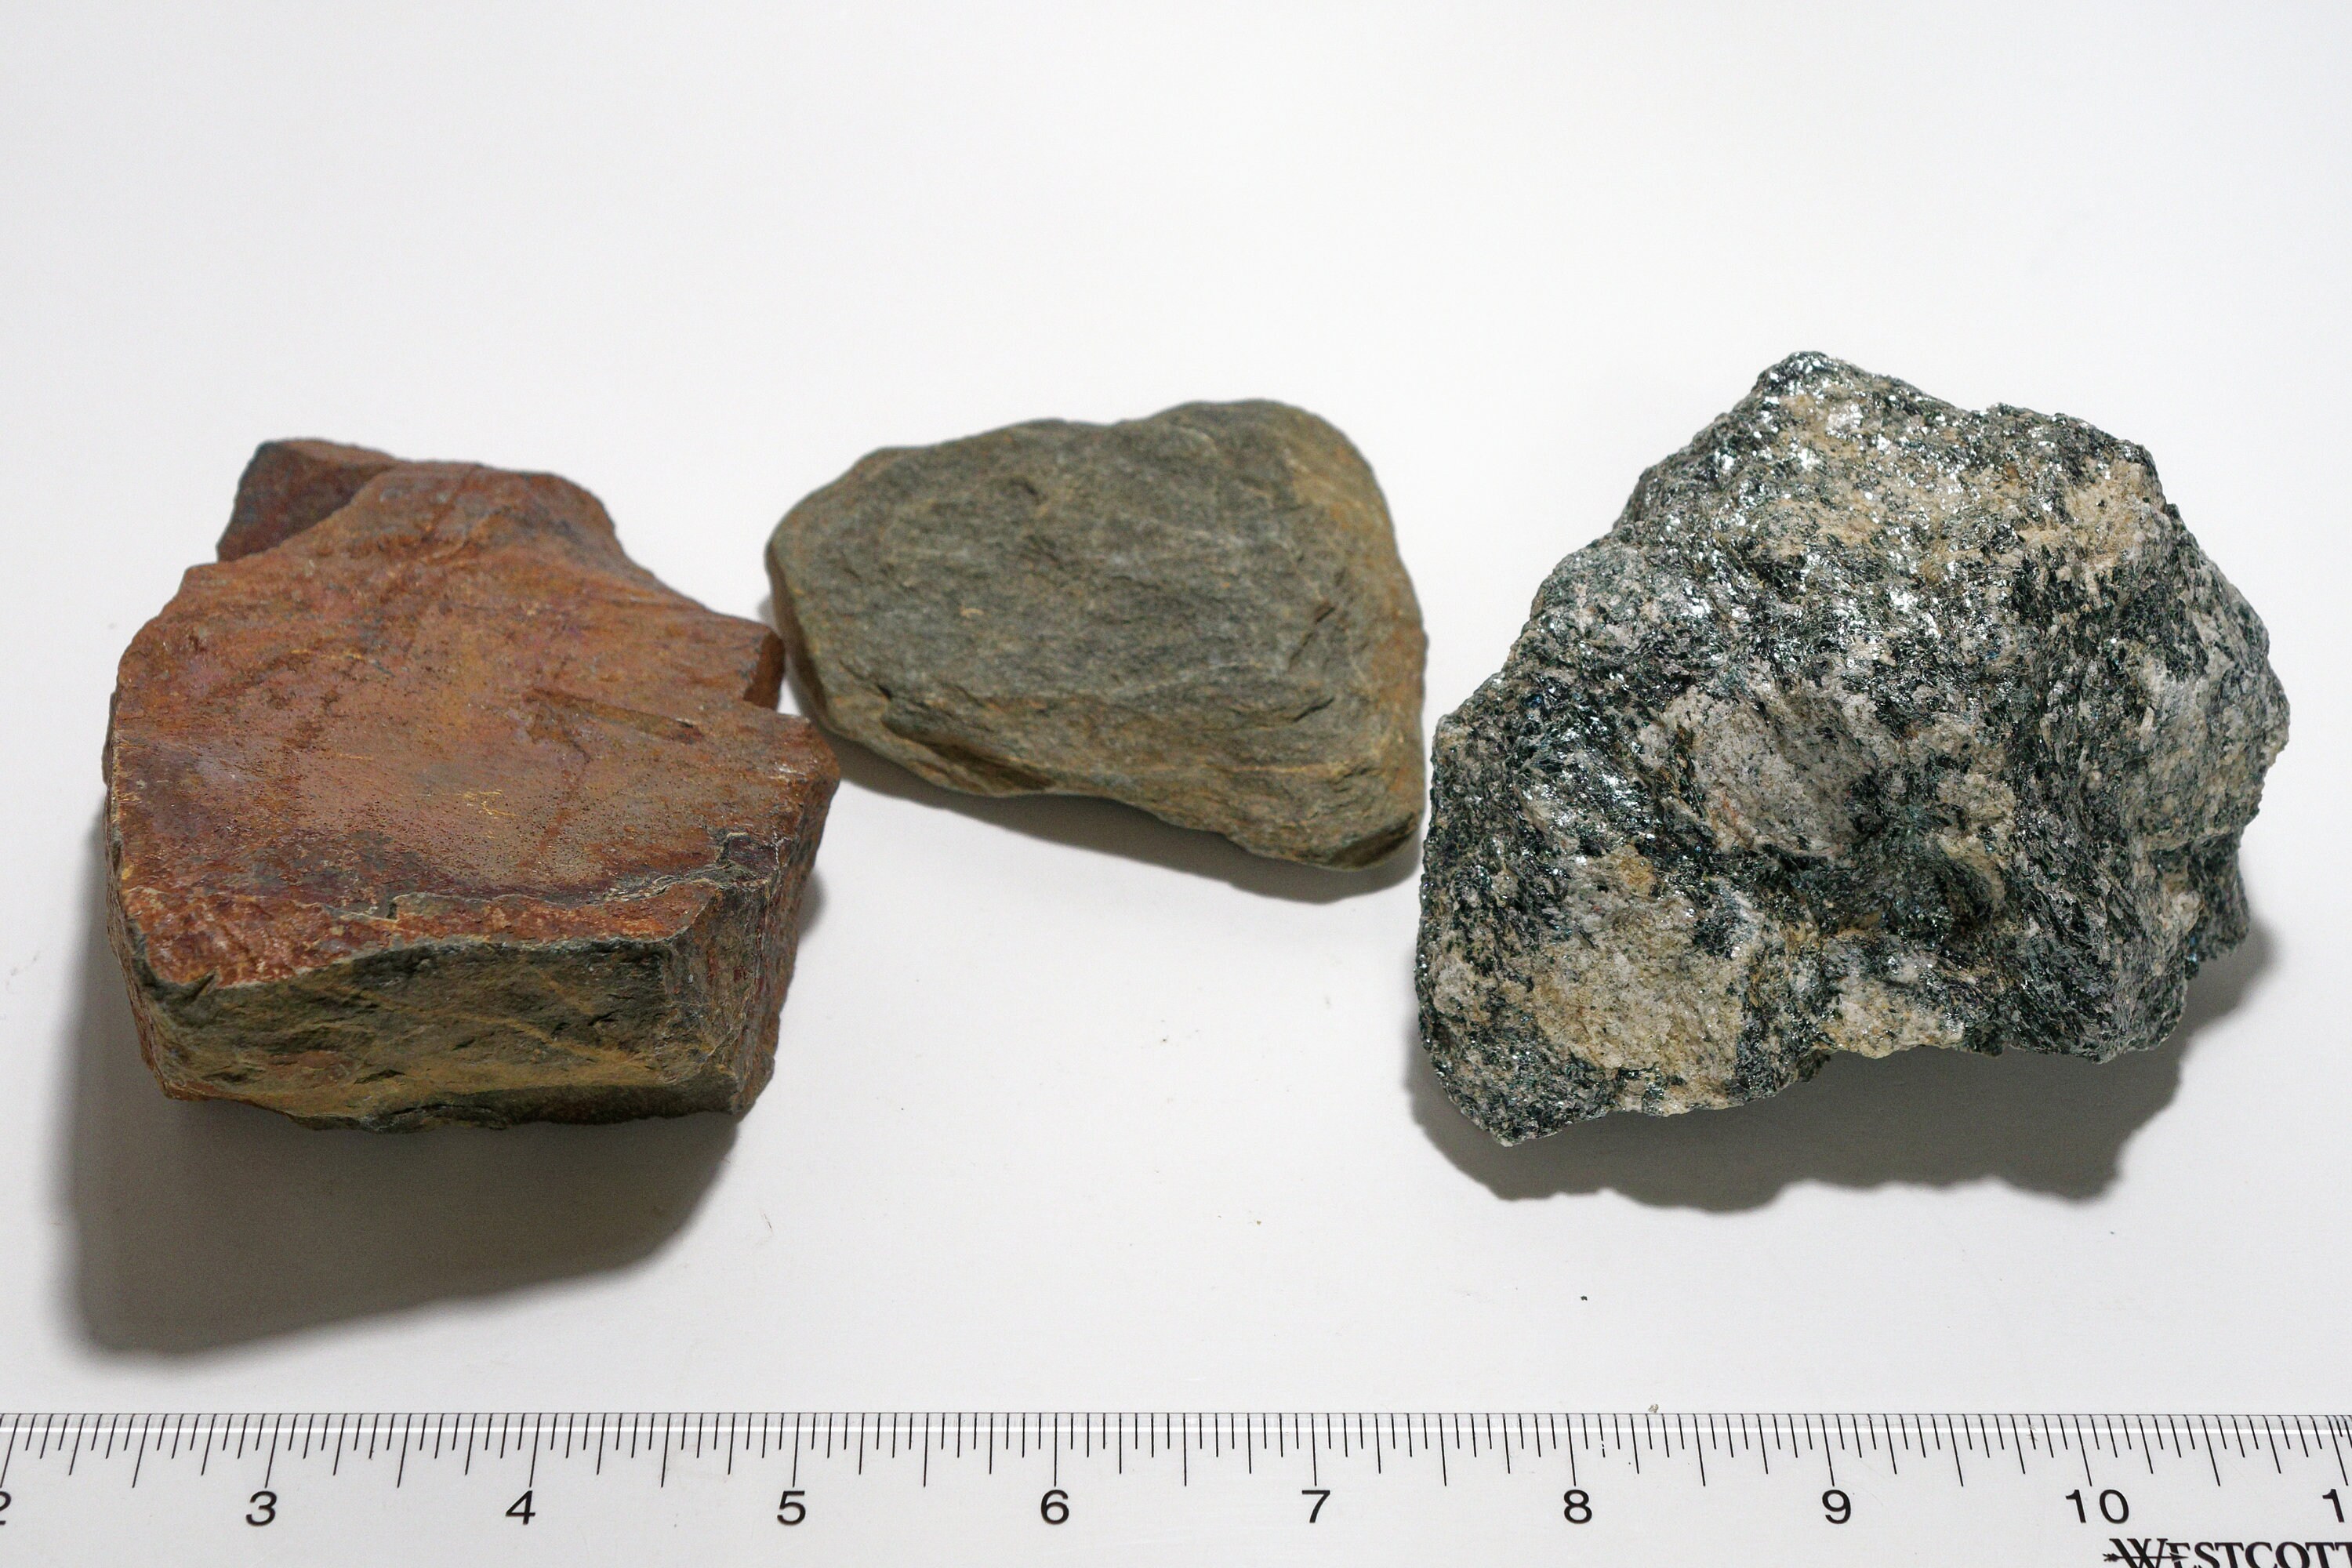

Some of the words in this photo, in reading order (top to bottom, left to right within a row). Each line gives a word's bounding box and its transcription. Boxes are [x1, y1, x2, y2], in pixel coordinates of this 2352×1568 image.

[245, 1490, 278, 1526] 3
[505, 1490, 536, 1526] 4
[776, 1490, 807, 1526] 5
[1040, 1489, 1070, 1526] 6
[1301, 1490, 1332, 1523] 7
[1563, 1489, 1593, 1525] 8
[1820, 1489, 1853, 1525] 9
[2065, 1489, 2130, 1525] 10
